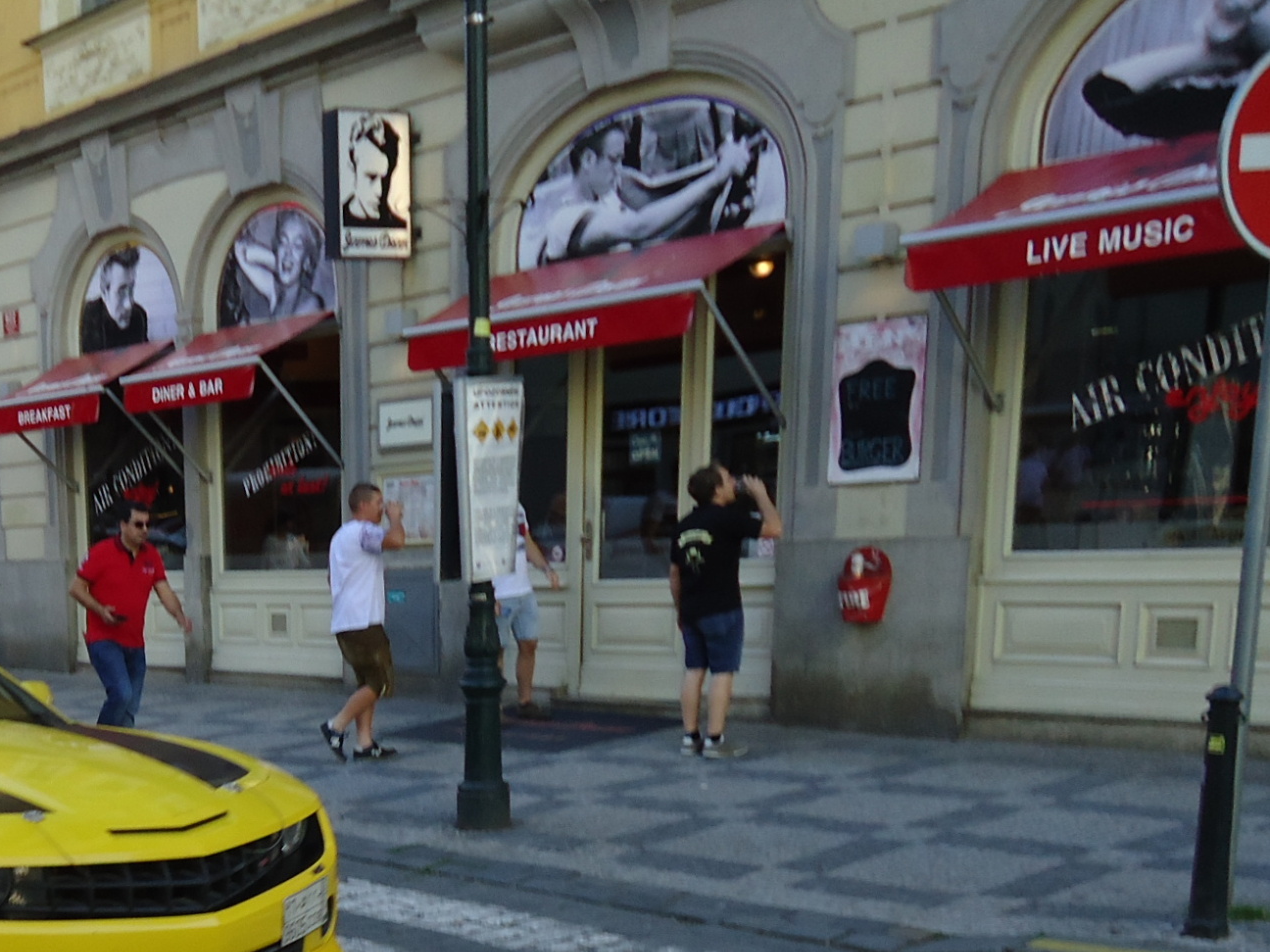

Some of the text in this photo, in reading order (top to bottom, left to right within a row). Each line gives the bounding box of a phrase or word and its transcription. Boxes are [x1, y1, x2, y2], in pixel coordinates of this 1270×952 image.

[1026, 213, 1196, 266] LIVE MUSIC
[151, 378, 224, 404] DINER & BAR
[1071, 375, 1126, 433] AIR
[18, 404, 72, 426] BREAKFAST
[93, 482, 114, 517] AIR
